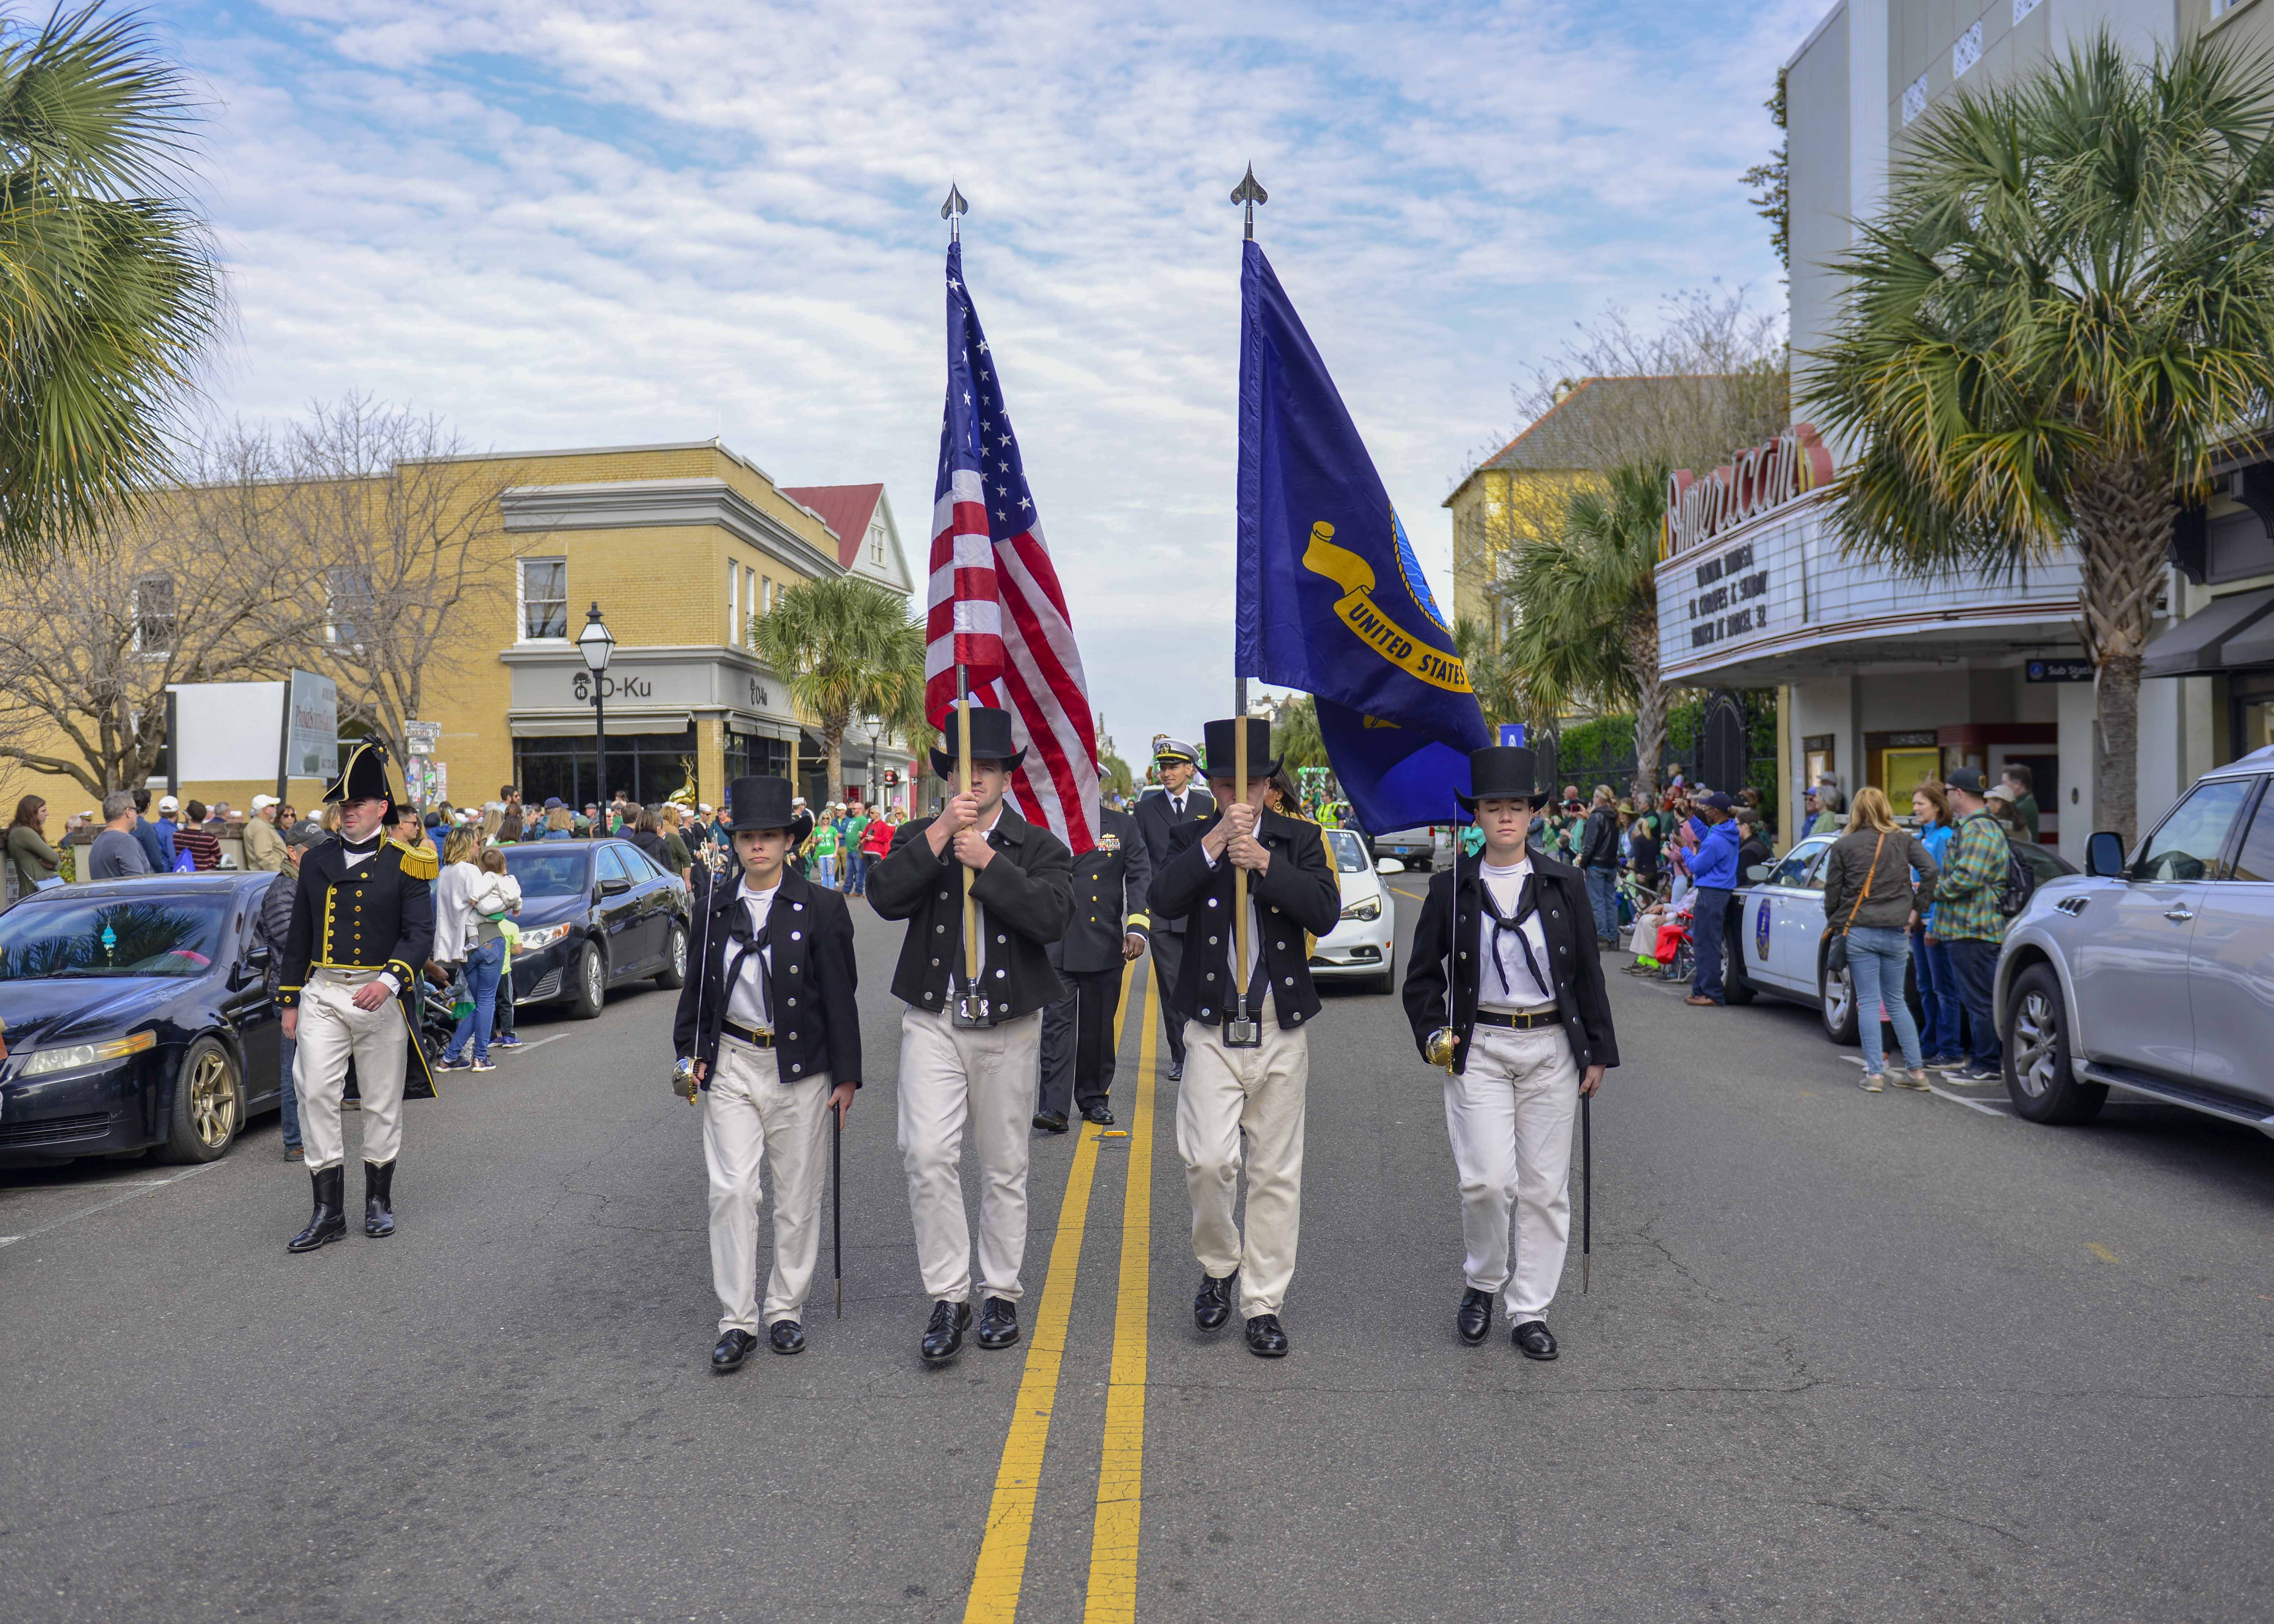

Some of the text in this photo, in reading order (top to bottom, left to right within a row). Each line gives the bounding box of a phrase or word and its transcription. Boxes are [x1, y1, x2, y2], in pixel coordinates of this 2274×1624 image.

[1349, 602, 1465, 685] UNITED STATES
[2048, 665, 2093, 676] Sub Stati
[602, 677, 651, 697] O-Ku
[756, 686, 767, 705] O-Ku
[407, 728, 429, 736] Radcliffe
